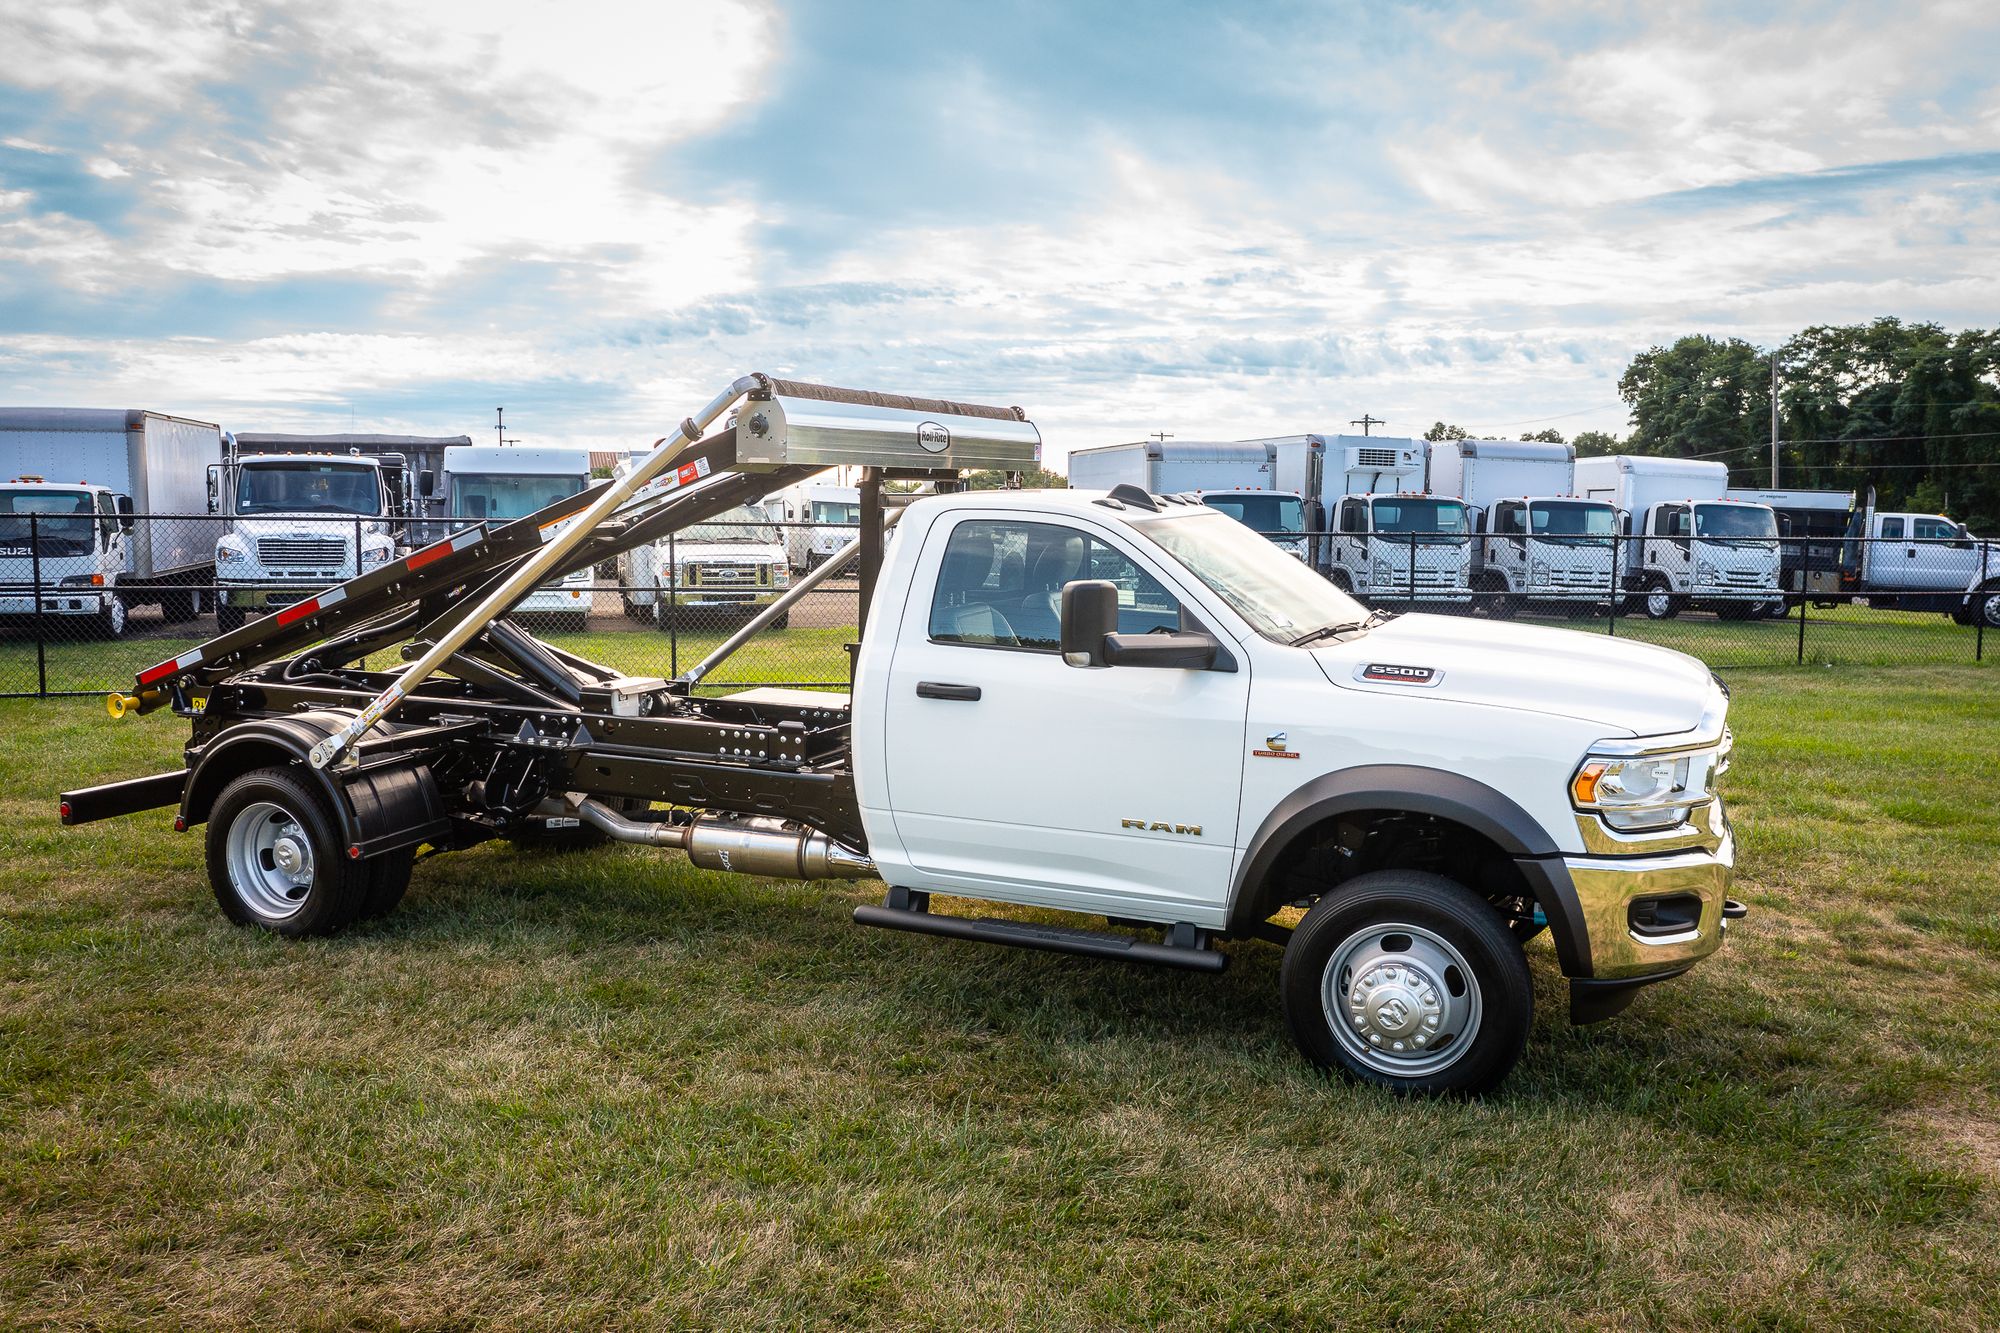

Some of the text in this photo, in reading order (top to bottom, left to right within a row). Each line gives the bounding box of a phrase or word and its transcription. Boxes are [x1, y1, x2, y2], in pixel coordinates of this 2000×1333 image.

[921, 430, 947, 444] Roll-Rite
[1371, 665, 1429, 677] 5500
[1121, 817, 1203, 837] RAM
